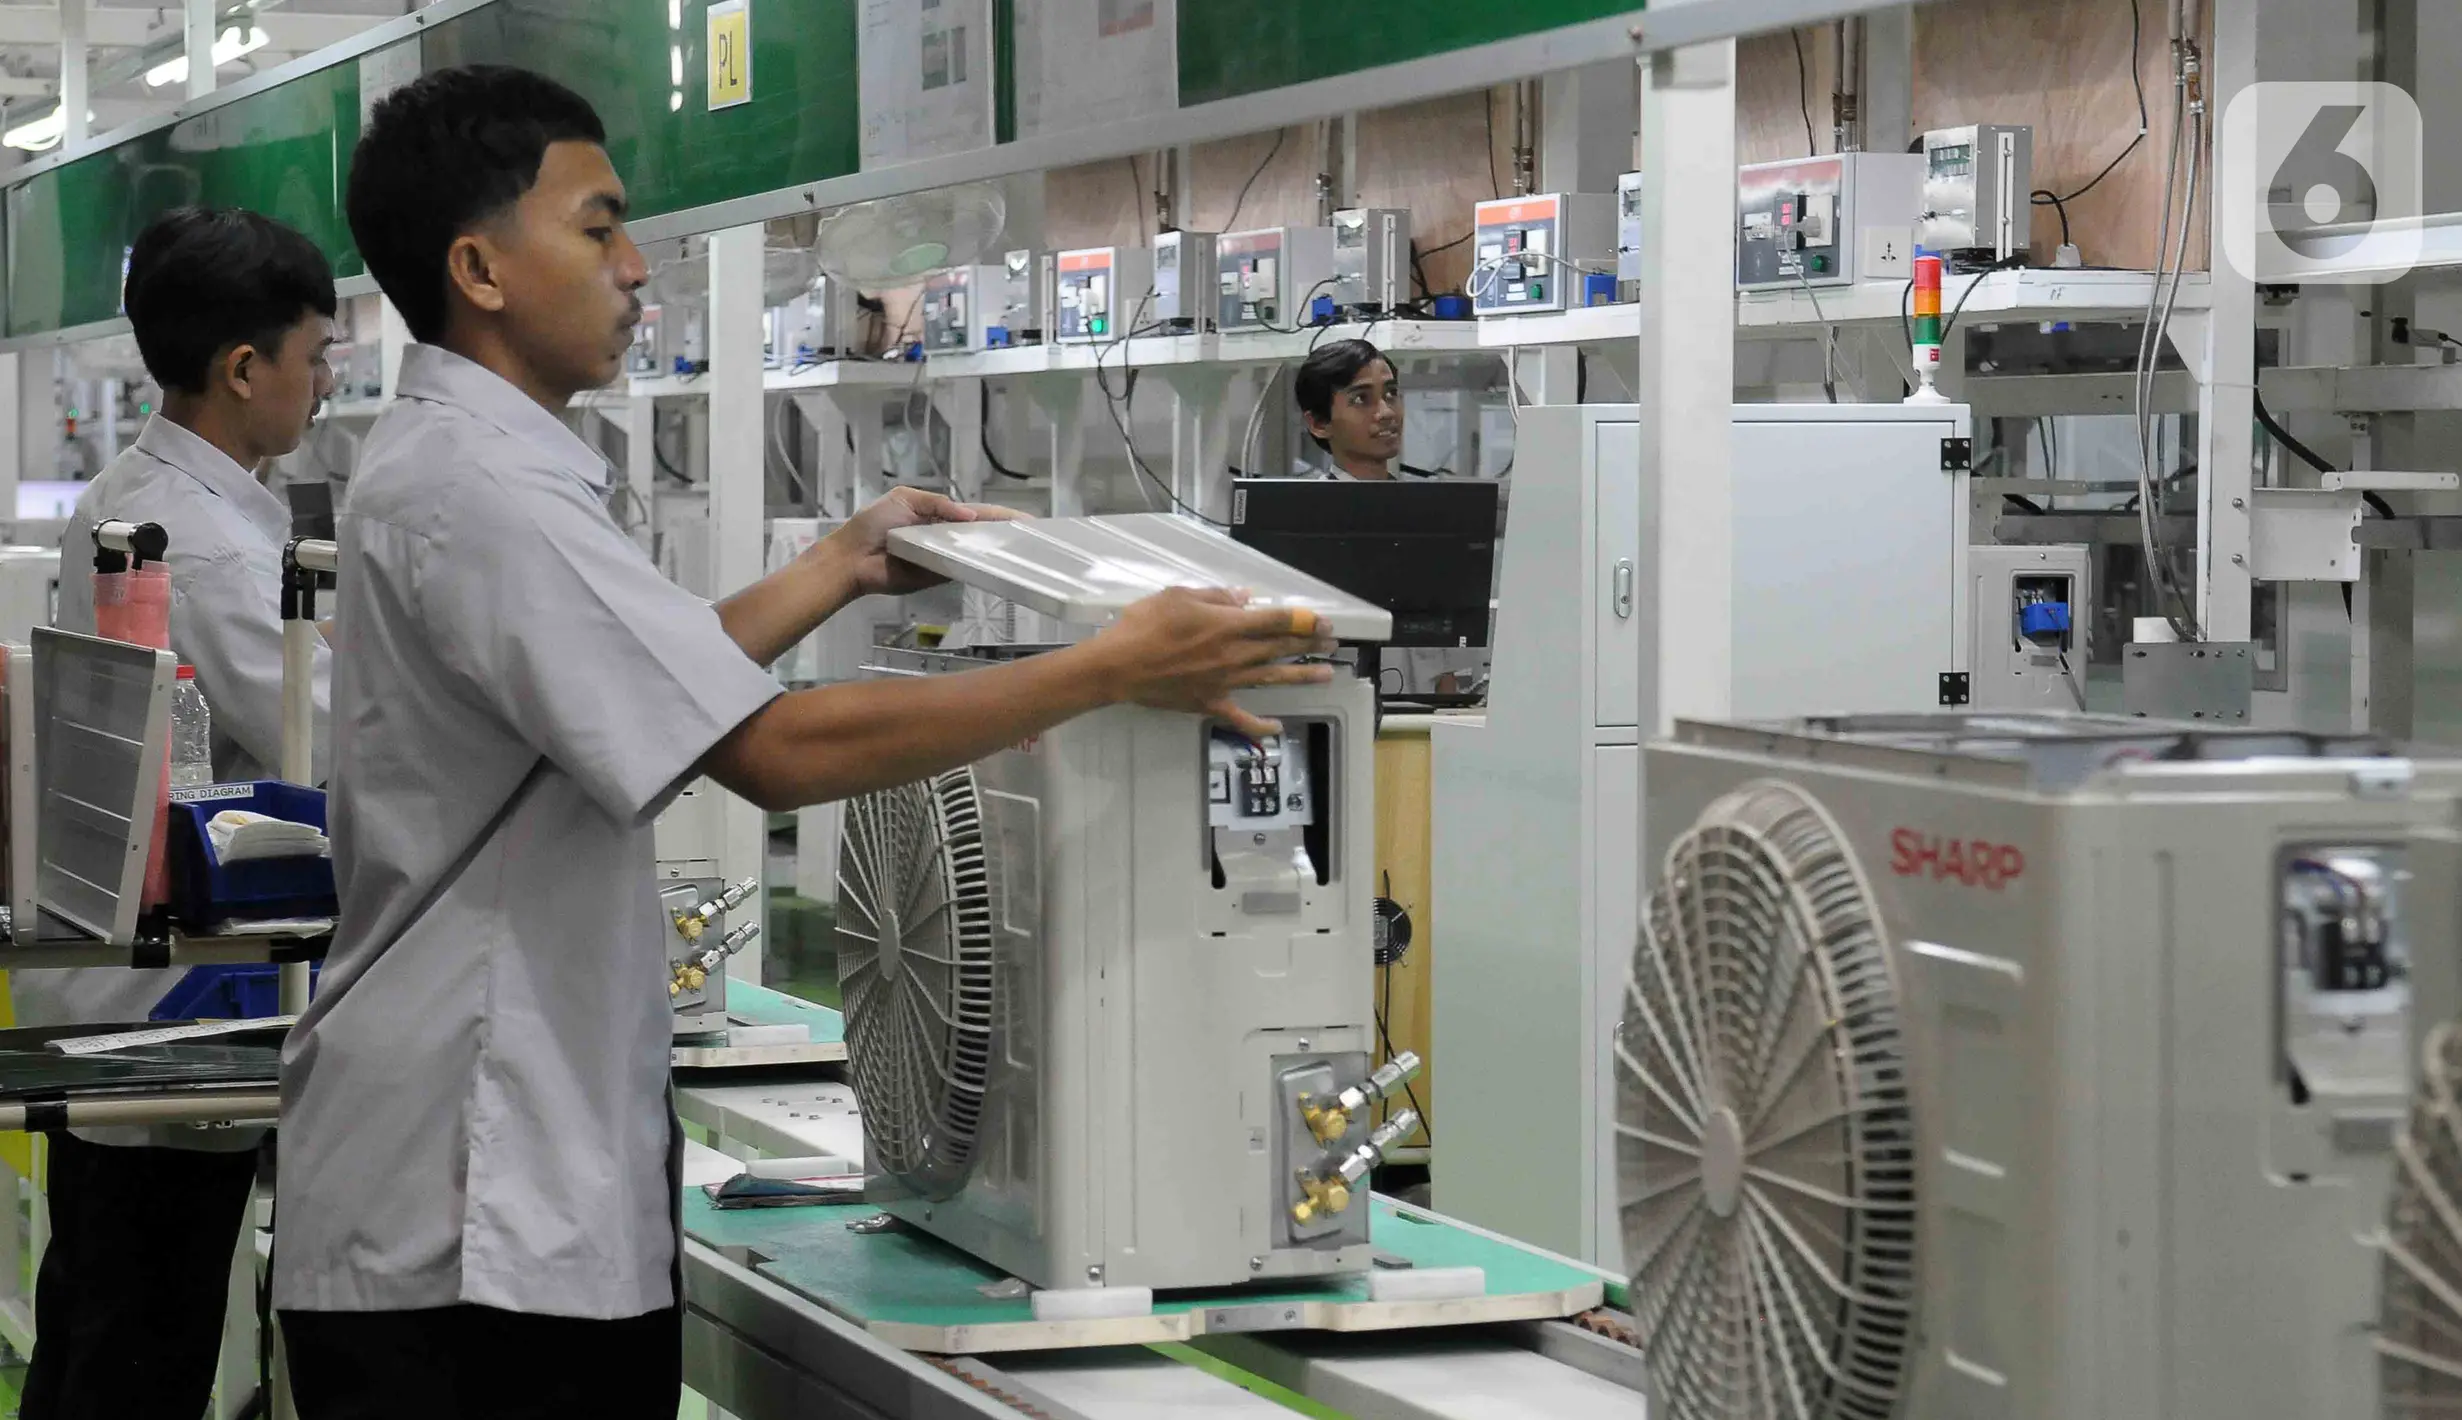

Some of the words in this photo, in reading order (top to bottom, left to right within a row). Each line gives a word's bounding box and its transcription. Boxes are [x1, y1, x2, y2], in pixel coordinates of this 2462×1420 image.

[719, 30, 738, 89] PL
[169, 790, 195, 800] RING
[200, 786, 251, 798] DIAGRAM
[1890, 827, 2024, 891] SHARP
